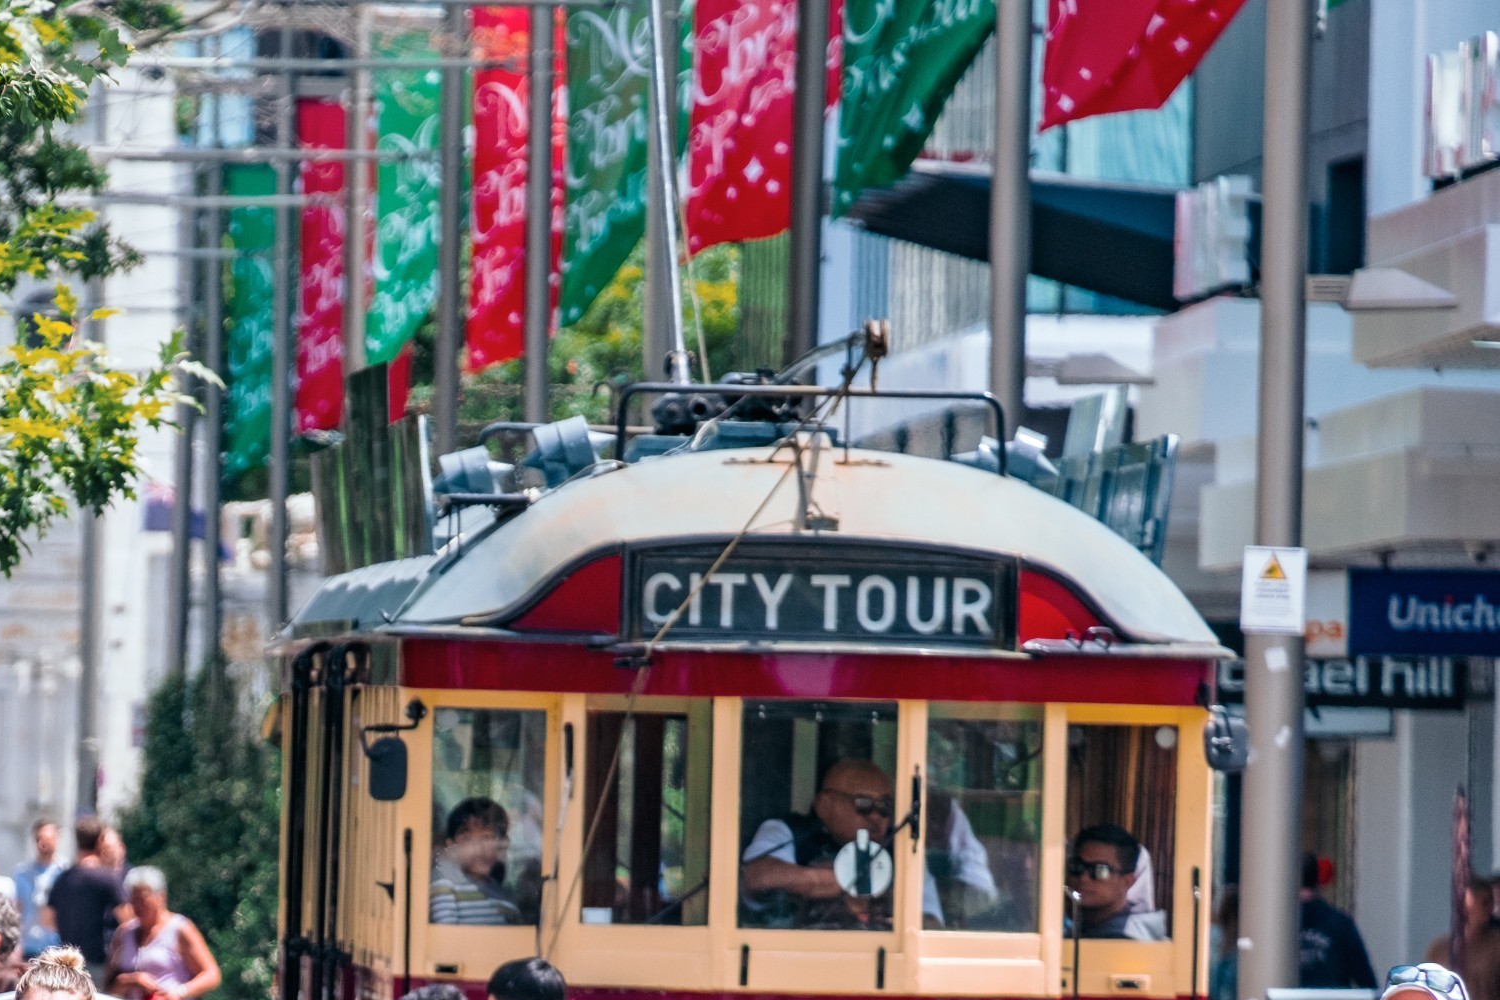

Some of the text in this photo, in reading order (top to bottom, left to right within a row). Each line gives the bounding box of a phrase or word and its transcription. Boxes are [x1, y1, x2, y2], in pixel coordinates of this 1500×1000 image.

[641, 572, 993, 635] CITY TOUR
[1387, 594, 1500, 632] Unich
[1381, 655, 1453, 697] hill
